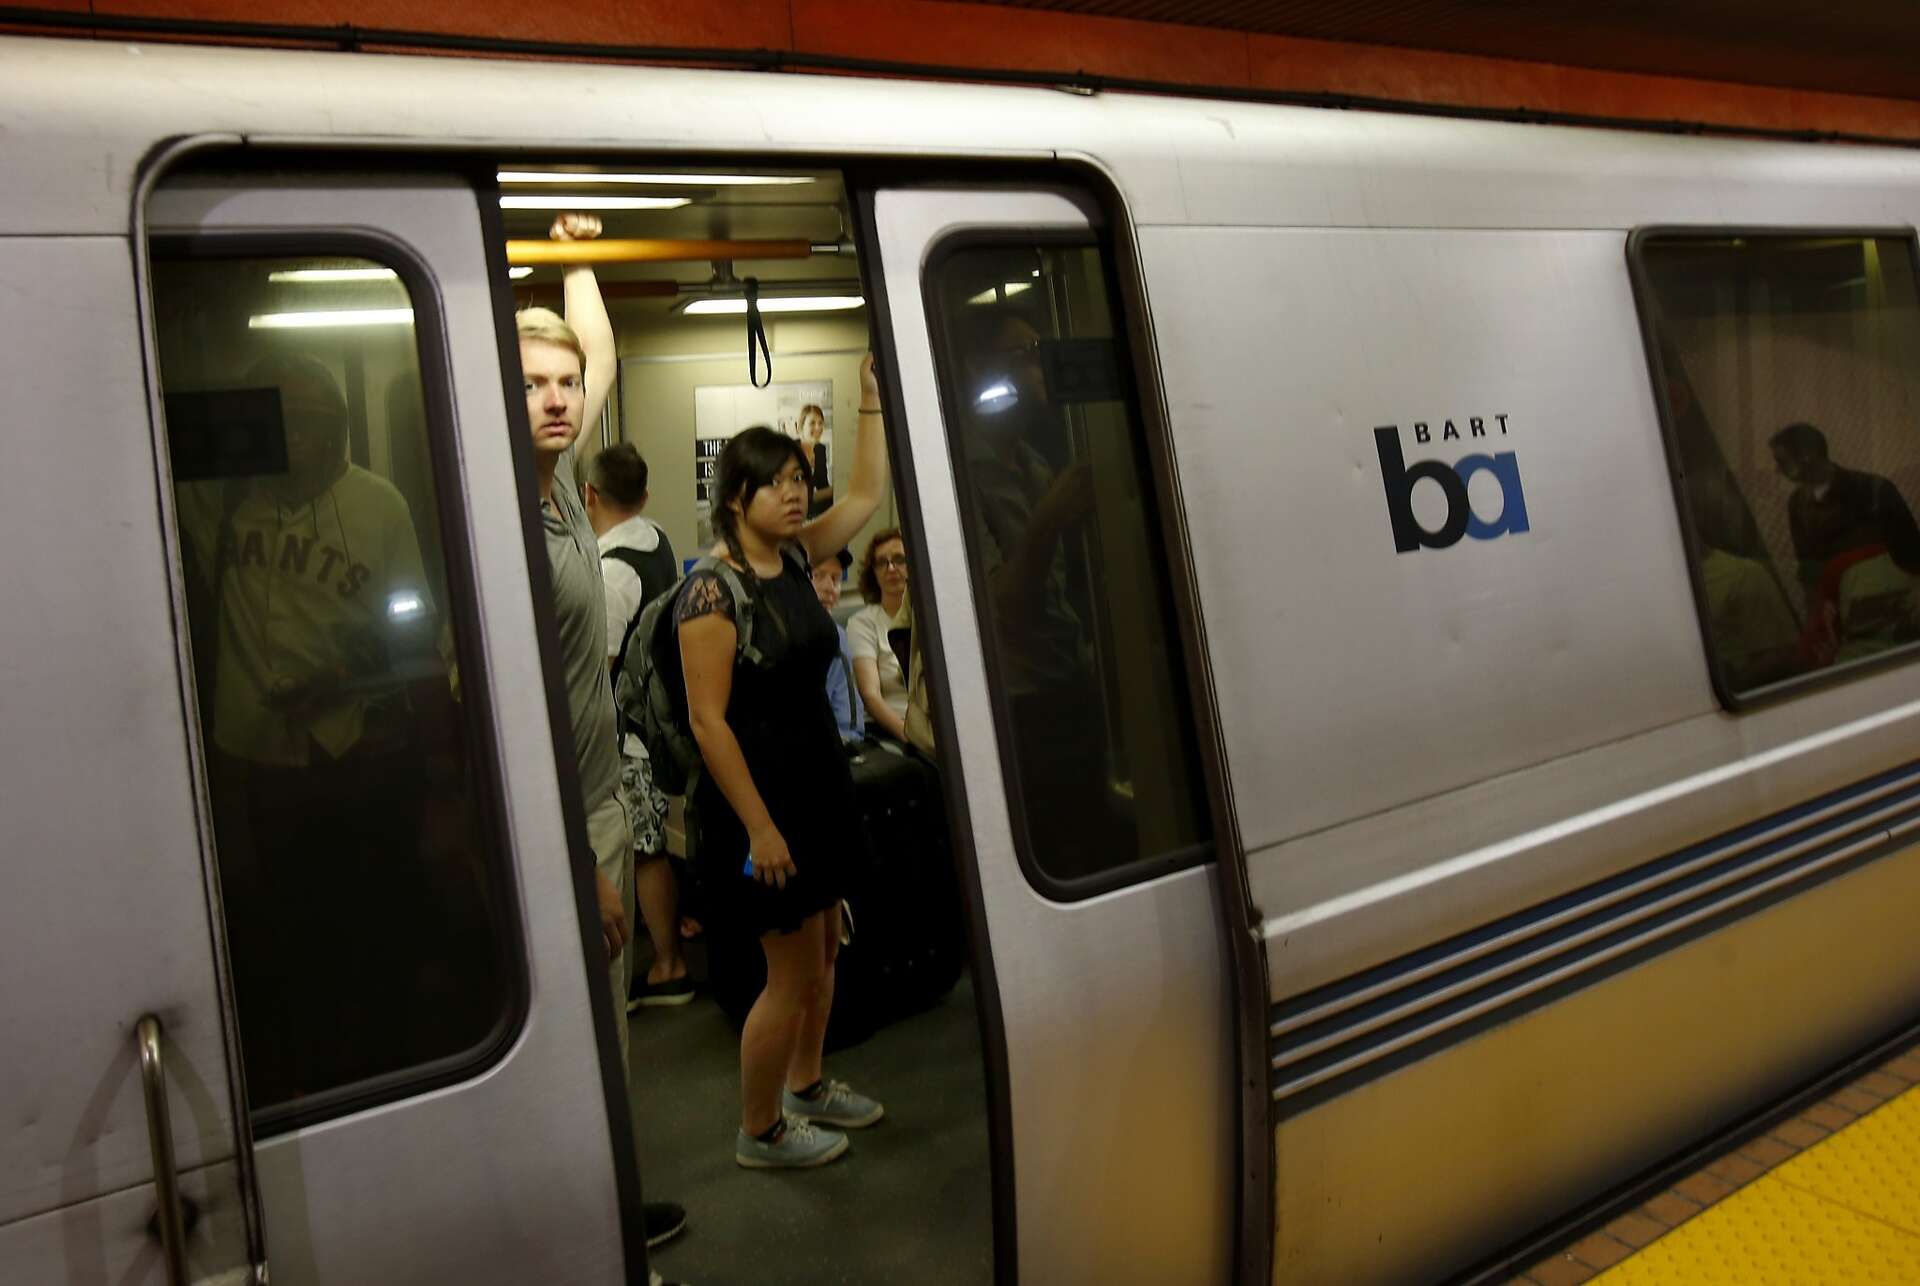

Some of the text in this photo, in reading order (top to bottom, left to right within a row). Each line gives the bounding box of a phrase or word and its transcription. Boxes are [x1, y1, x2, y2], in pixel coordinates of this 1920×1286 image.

[1414, 414, 1509, 443] BART
[1373, 425, 1530, 553] ba
[236, 528, 371, 597] ANTS
